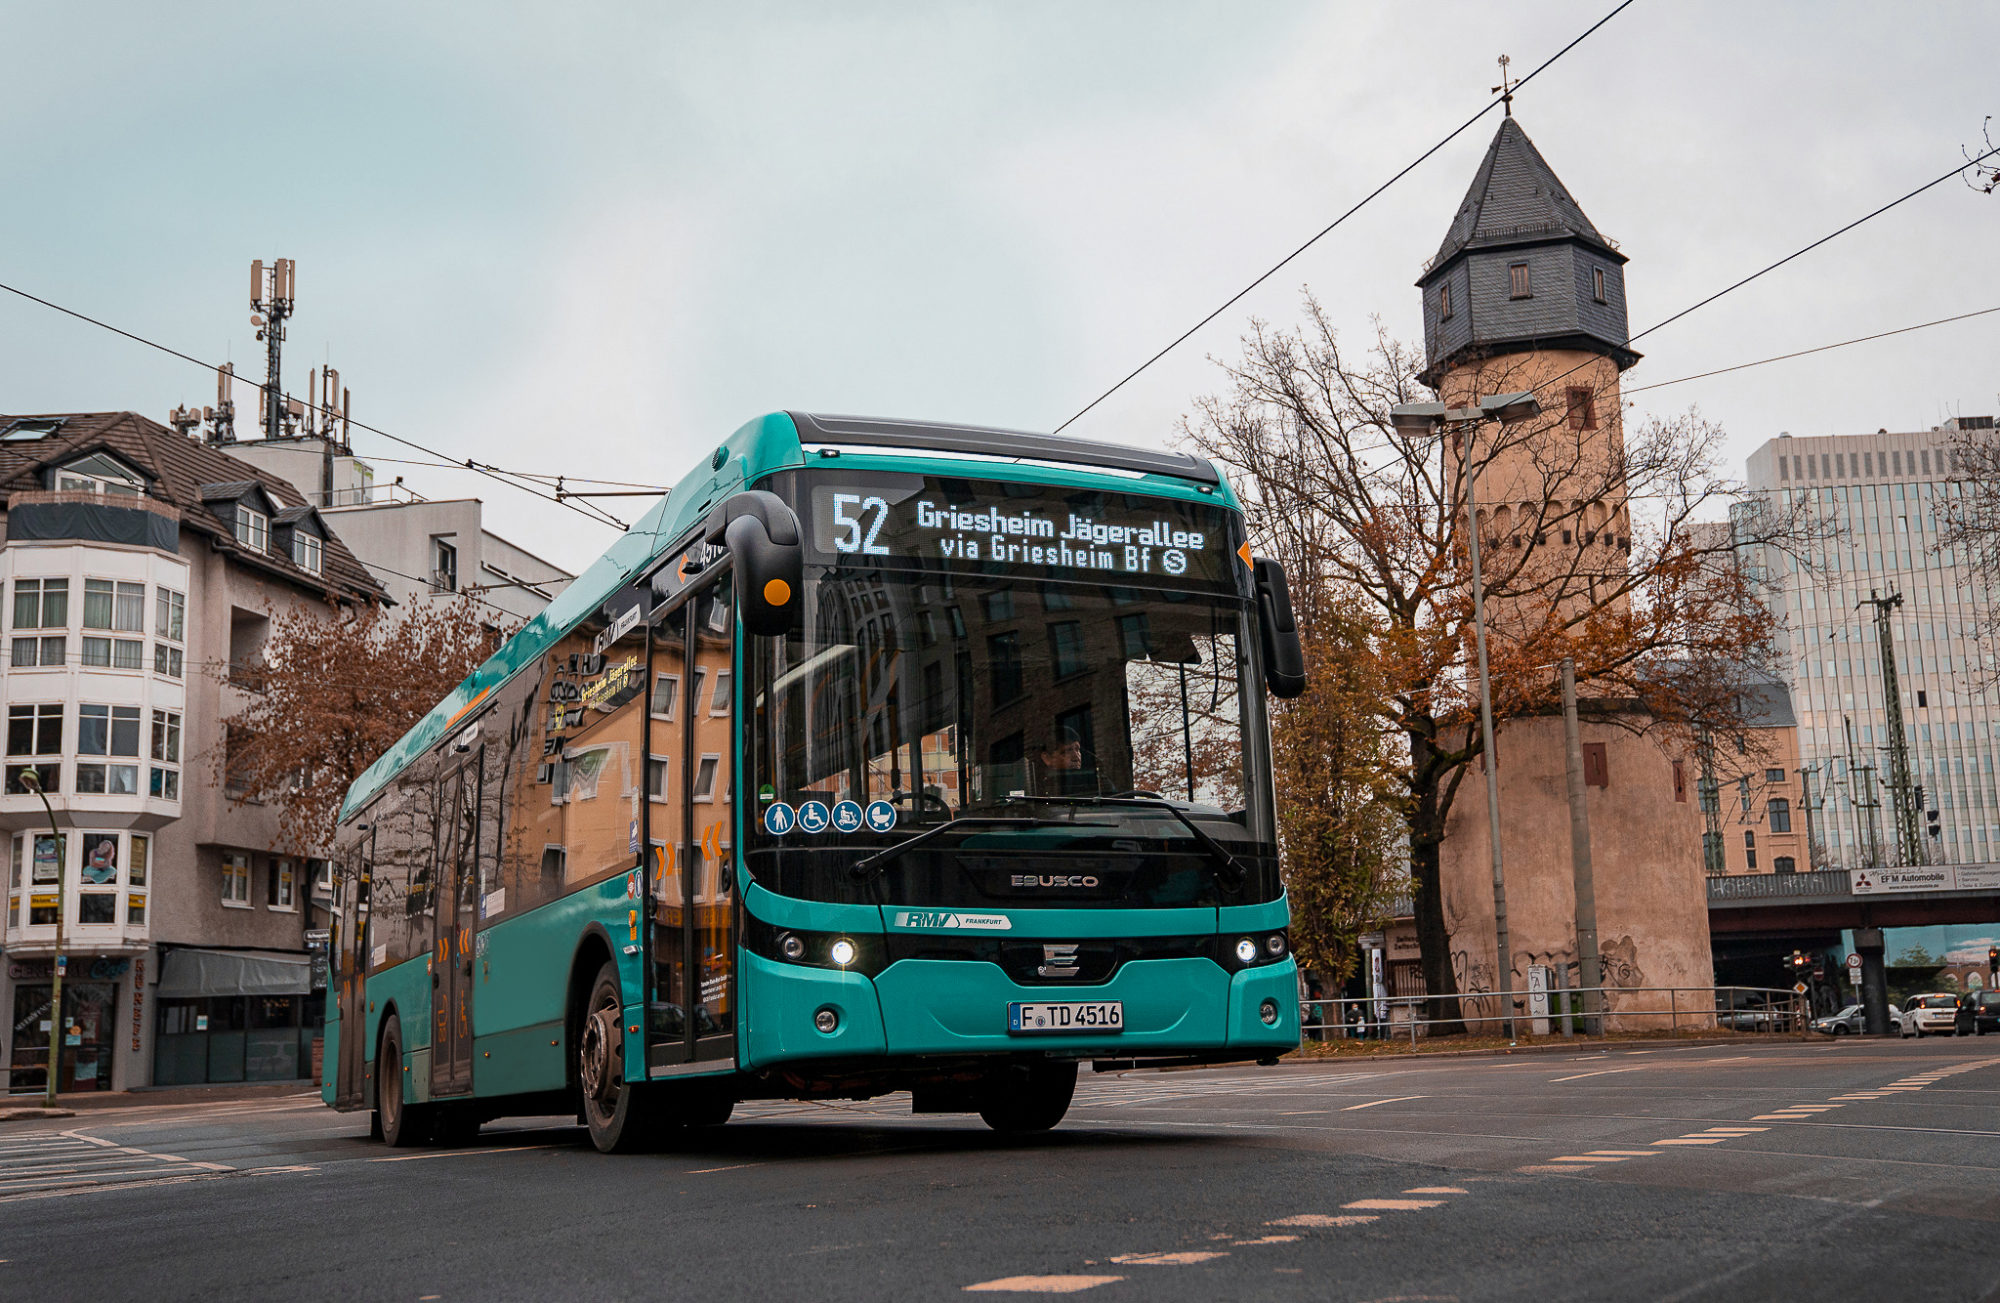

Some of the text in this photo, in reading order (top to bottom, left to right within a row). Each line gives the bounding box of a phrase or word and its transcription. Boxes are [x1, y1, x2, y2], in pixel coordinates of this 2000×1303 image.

[834, 493, 890, 555] 52
[918, 500, 1204, 549] Griesheim Jägerallee
[941, 533, 979, 559] via
[991, 534, 1113, 570] Griesheim
[1125, 545, 1150, 572] Bf
[1011, 875, 1099, 887] EBUSCO
[1901, 873, 1945, 883] Automobile
[905, 912, 952, 928] RMV
[1022, 1005, 1120, 1027] F TD 4516
